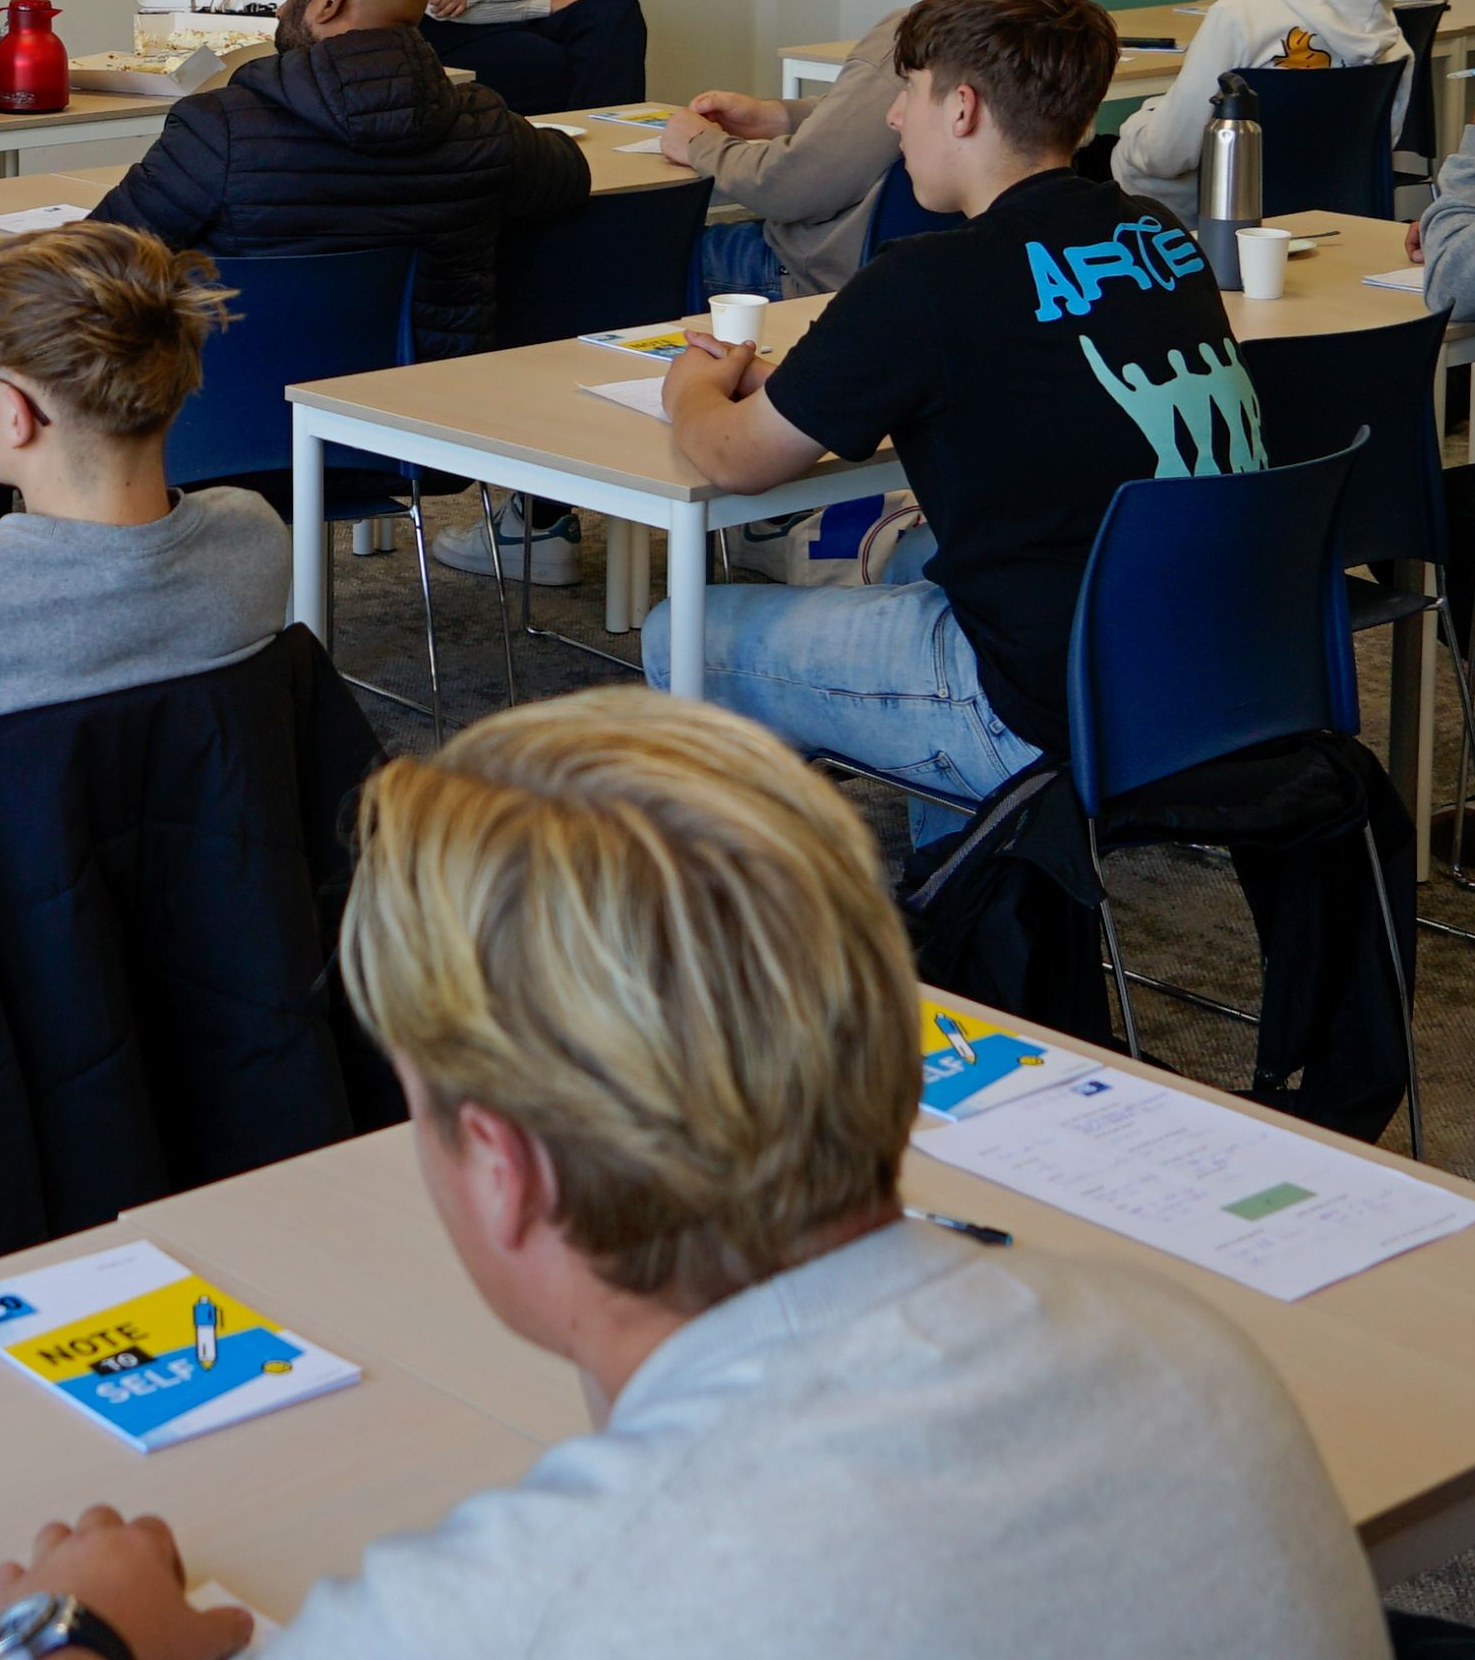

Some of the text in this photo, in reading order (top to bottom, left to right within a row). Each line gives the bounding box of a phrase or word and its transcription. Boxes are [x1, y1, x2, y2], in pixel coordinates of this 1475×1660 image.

[35, 1321, 150, 1366] NOTE
[100, 1352, 139, 1372] TO
[95, 1357, 196, 1405] SELF
